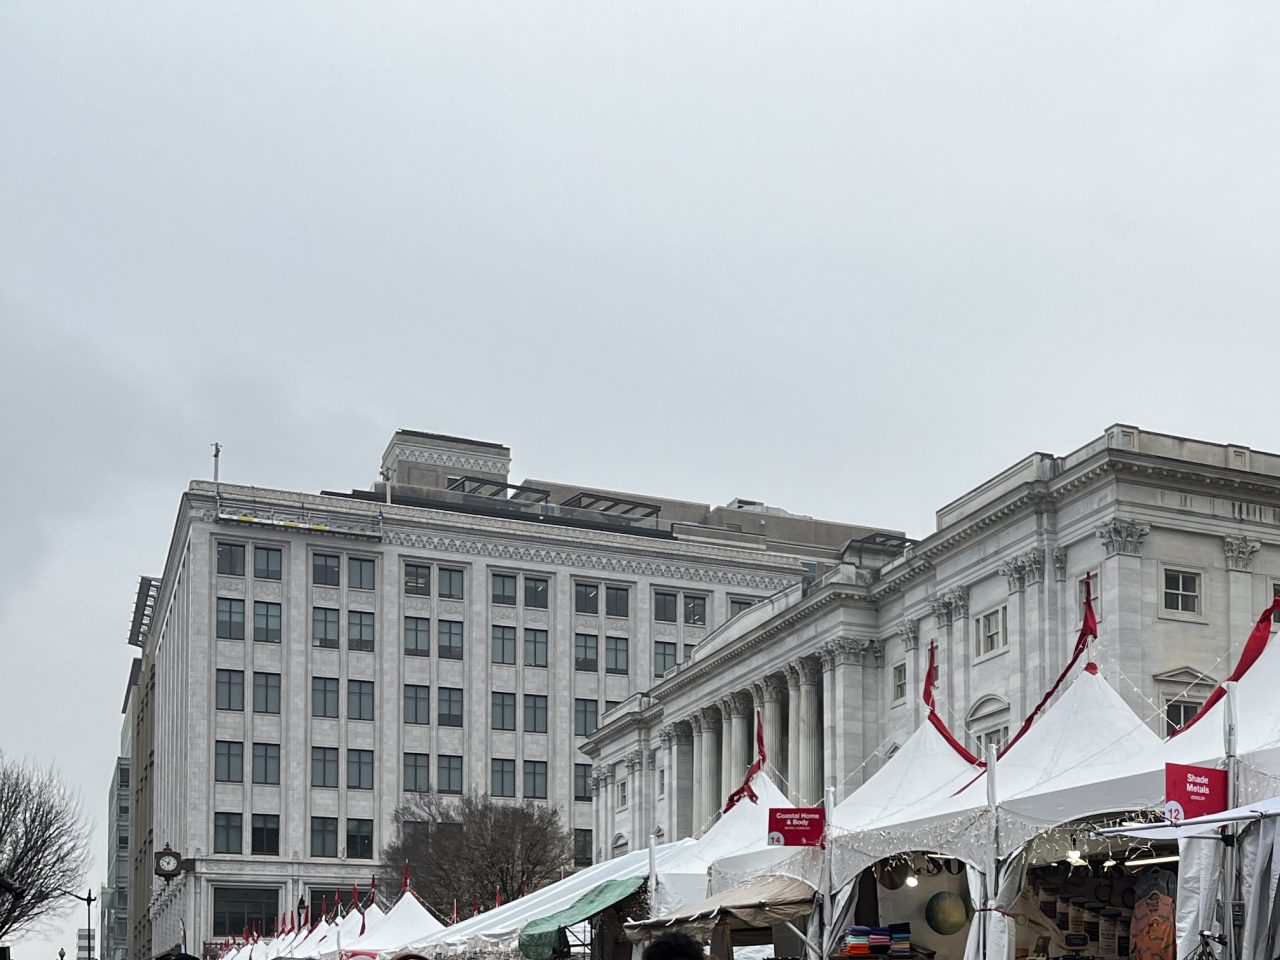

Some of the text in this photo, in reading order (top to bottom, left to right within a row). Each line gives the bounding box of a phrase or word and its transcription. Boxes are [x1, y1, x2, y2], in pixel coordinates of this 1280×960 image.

[1187, 773, 1209, 784] Shade
[1186, 783, 1210, 794] Metals
[1168, 808, 1180, 819] 12
[770, 836, 781, 844] 14
